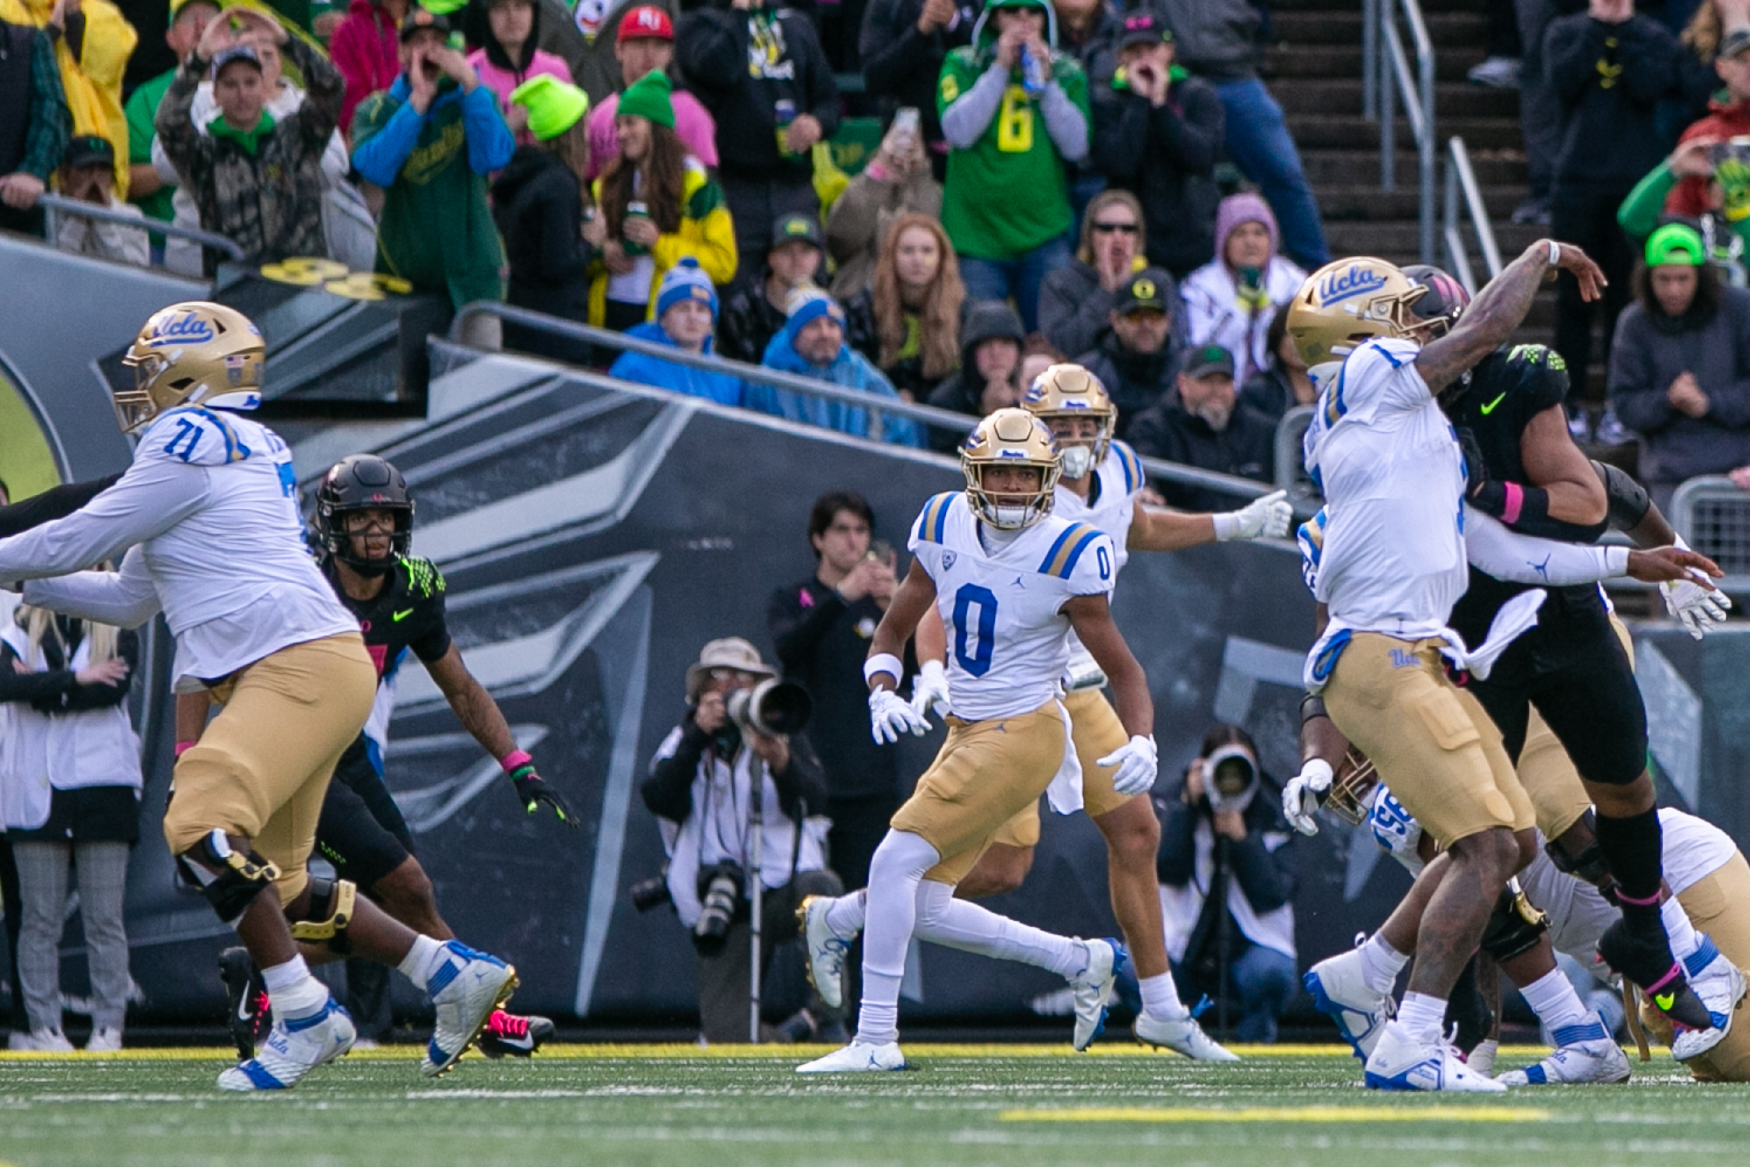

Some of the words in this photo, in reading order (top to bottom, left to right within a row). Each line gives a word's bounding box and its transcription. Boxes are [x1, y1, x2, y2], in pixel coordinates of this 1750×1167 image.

[998, 85, 1034, 153] 6
[164, 417, 205, 463] 71
[1097, 546, 1111, 580] 0
[952, 584, 998, 678] 0
